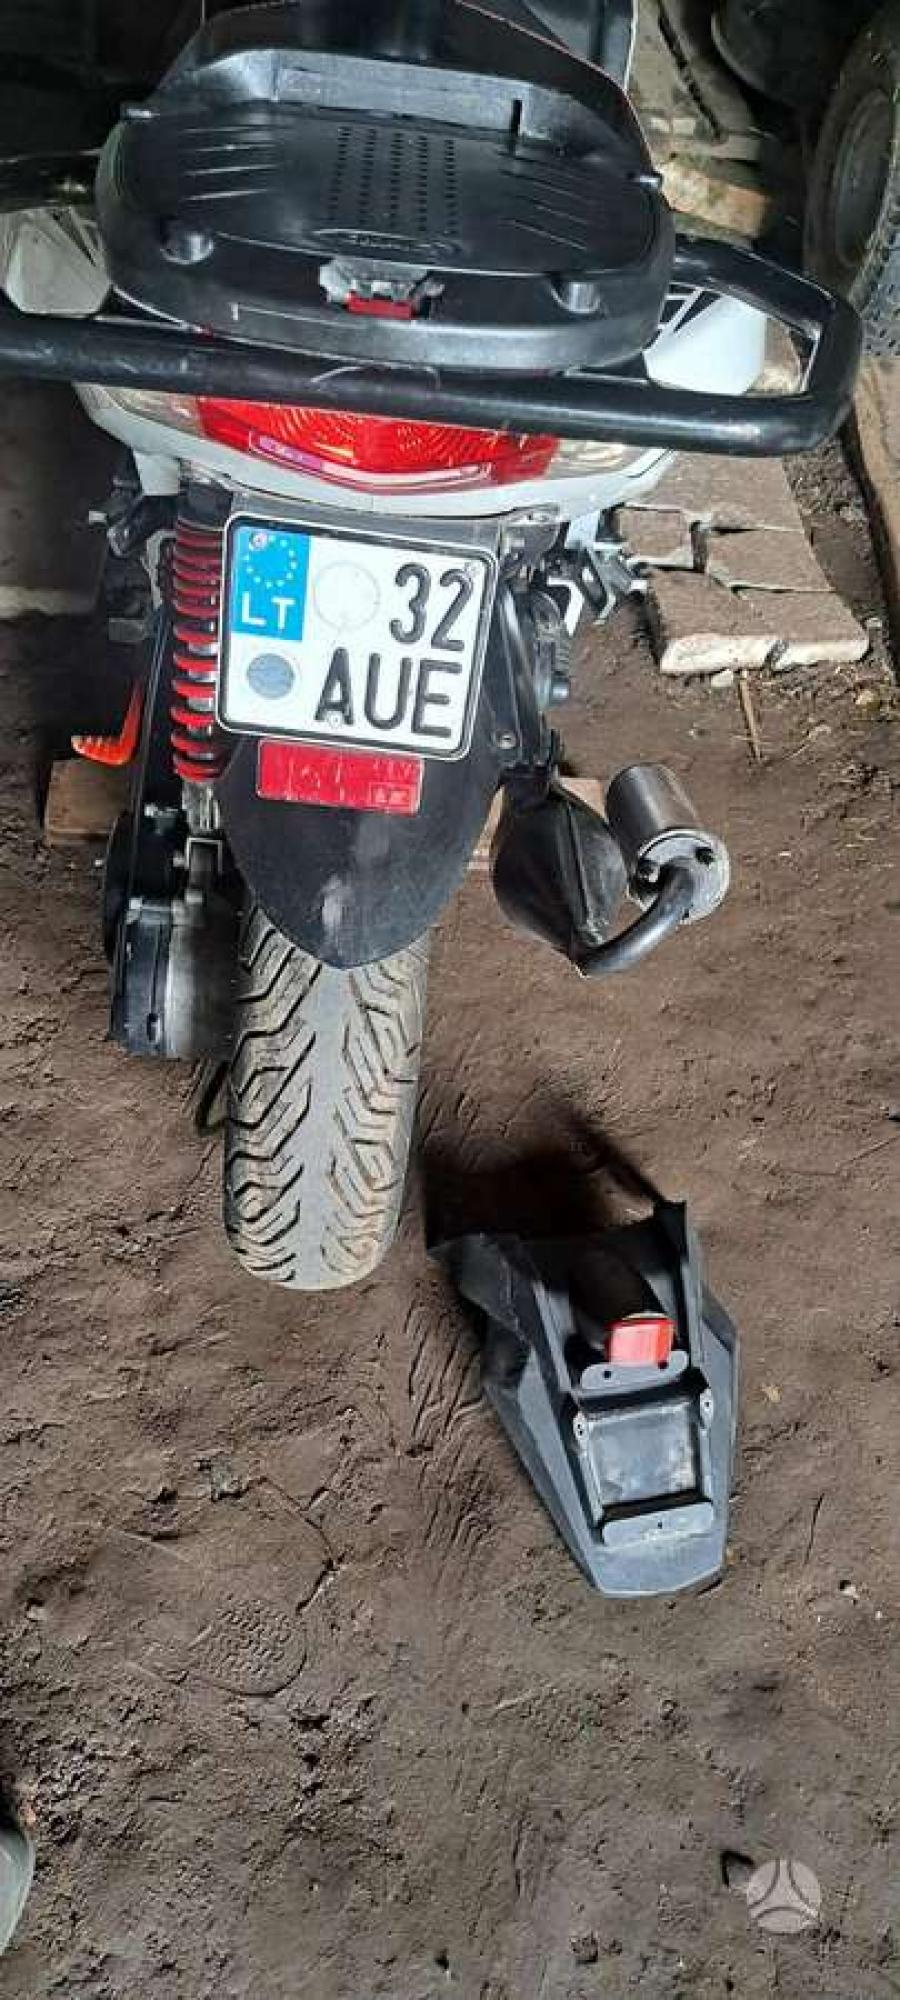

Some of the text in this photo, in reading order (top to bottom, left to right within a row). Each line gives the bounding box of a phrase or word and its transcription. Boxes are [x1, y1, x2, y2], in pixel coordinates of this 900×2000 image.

[241, 590, 296, 630] LT
[390, 562, 474, 652] 32
[313, 647, 463, 738] AUE
